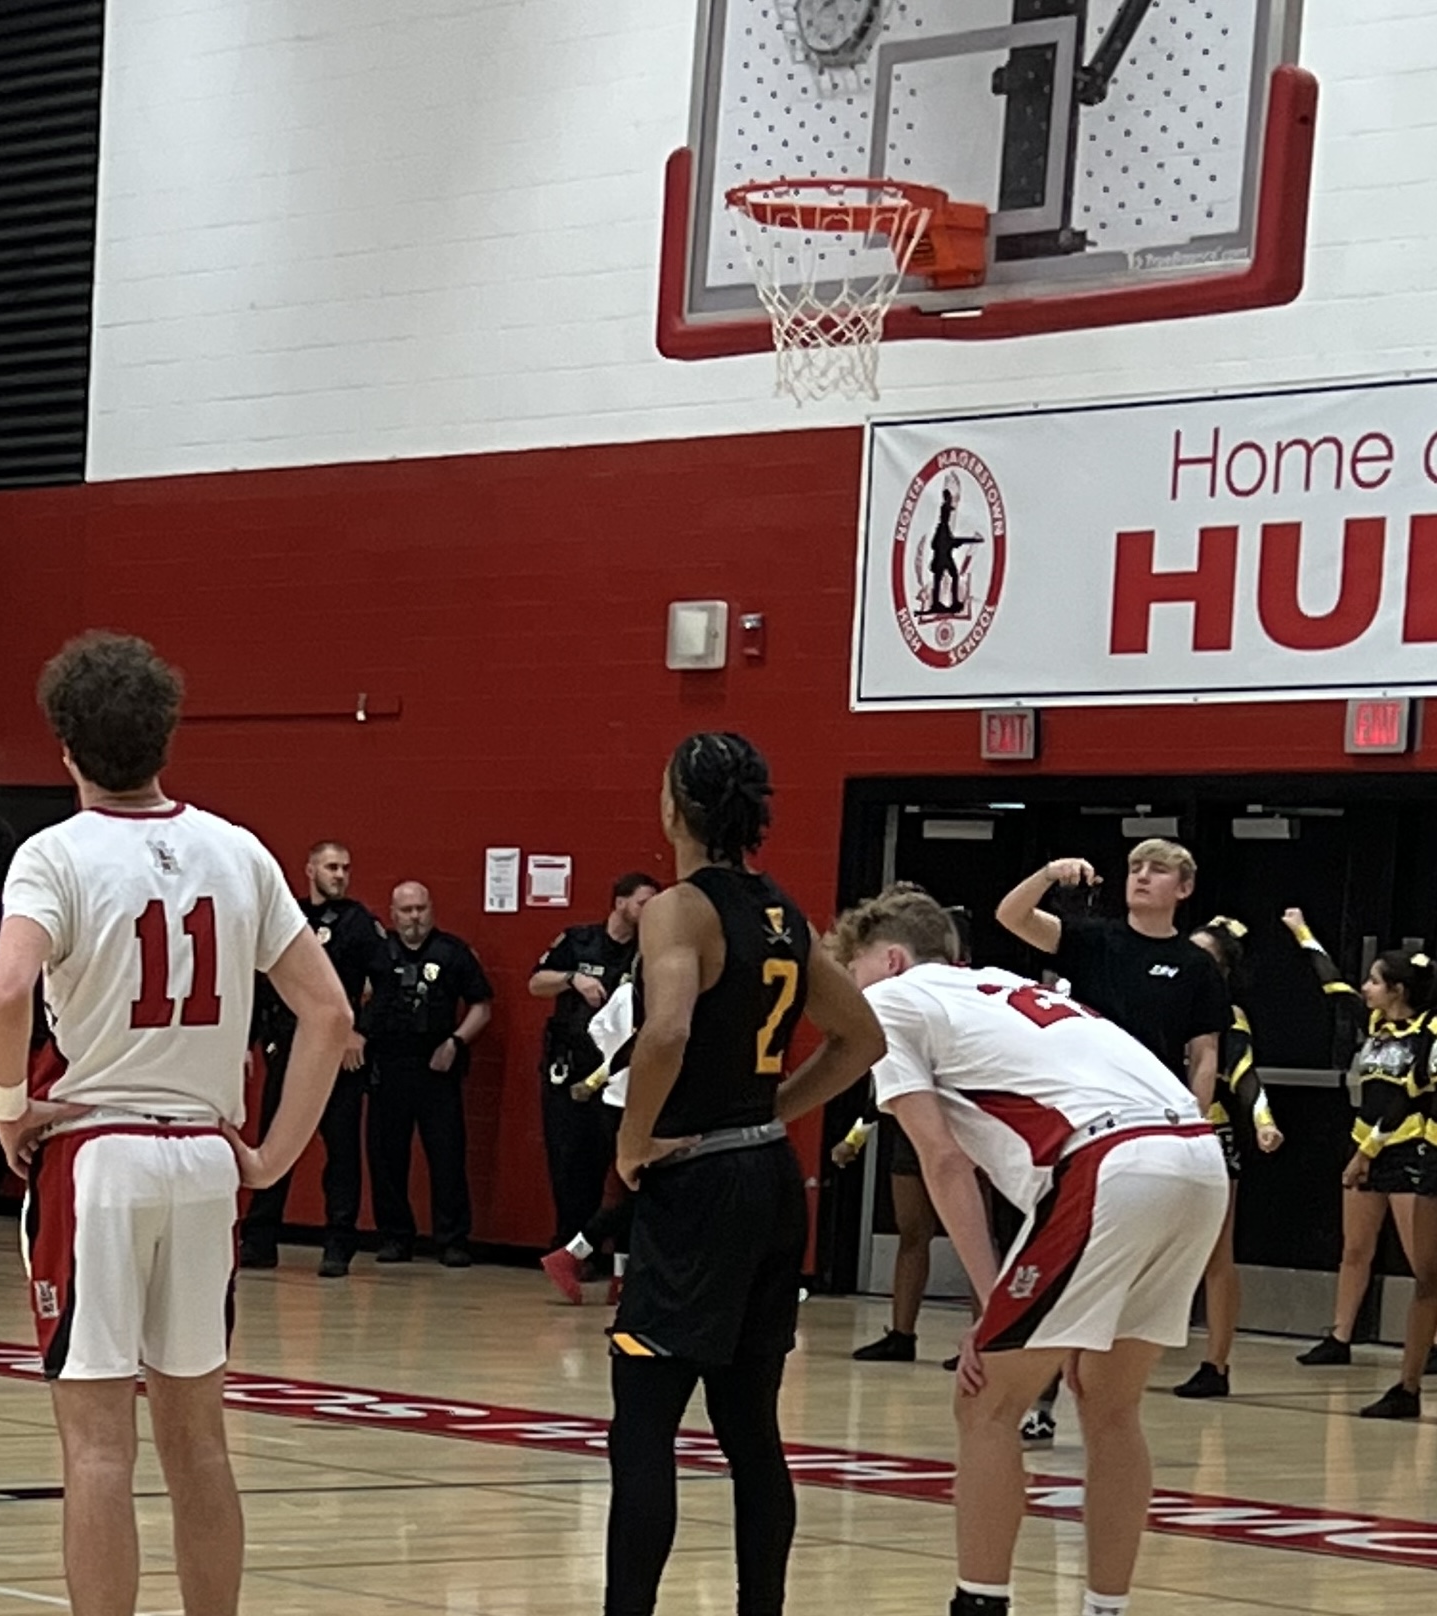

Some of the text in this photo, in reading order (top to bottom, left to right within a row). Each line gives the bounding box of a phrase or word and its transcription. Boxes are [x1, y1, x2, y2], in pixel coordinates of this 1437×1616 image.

[936, 450, 1005, 537] HAGERSTOWN
[1170, 426, 1395, 501] Home
[130, 896, 222, 1029] 11
[755, 957, 799, 1074] 2
